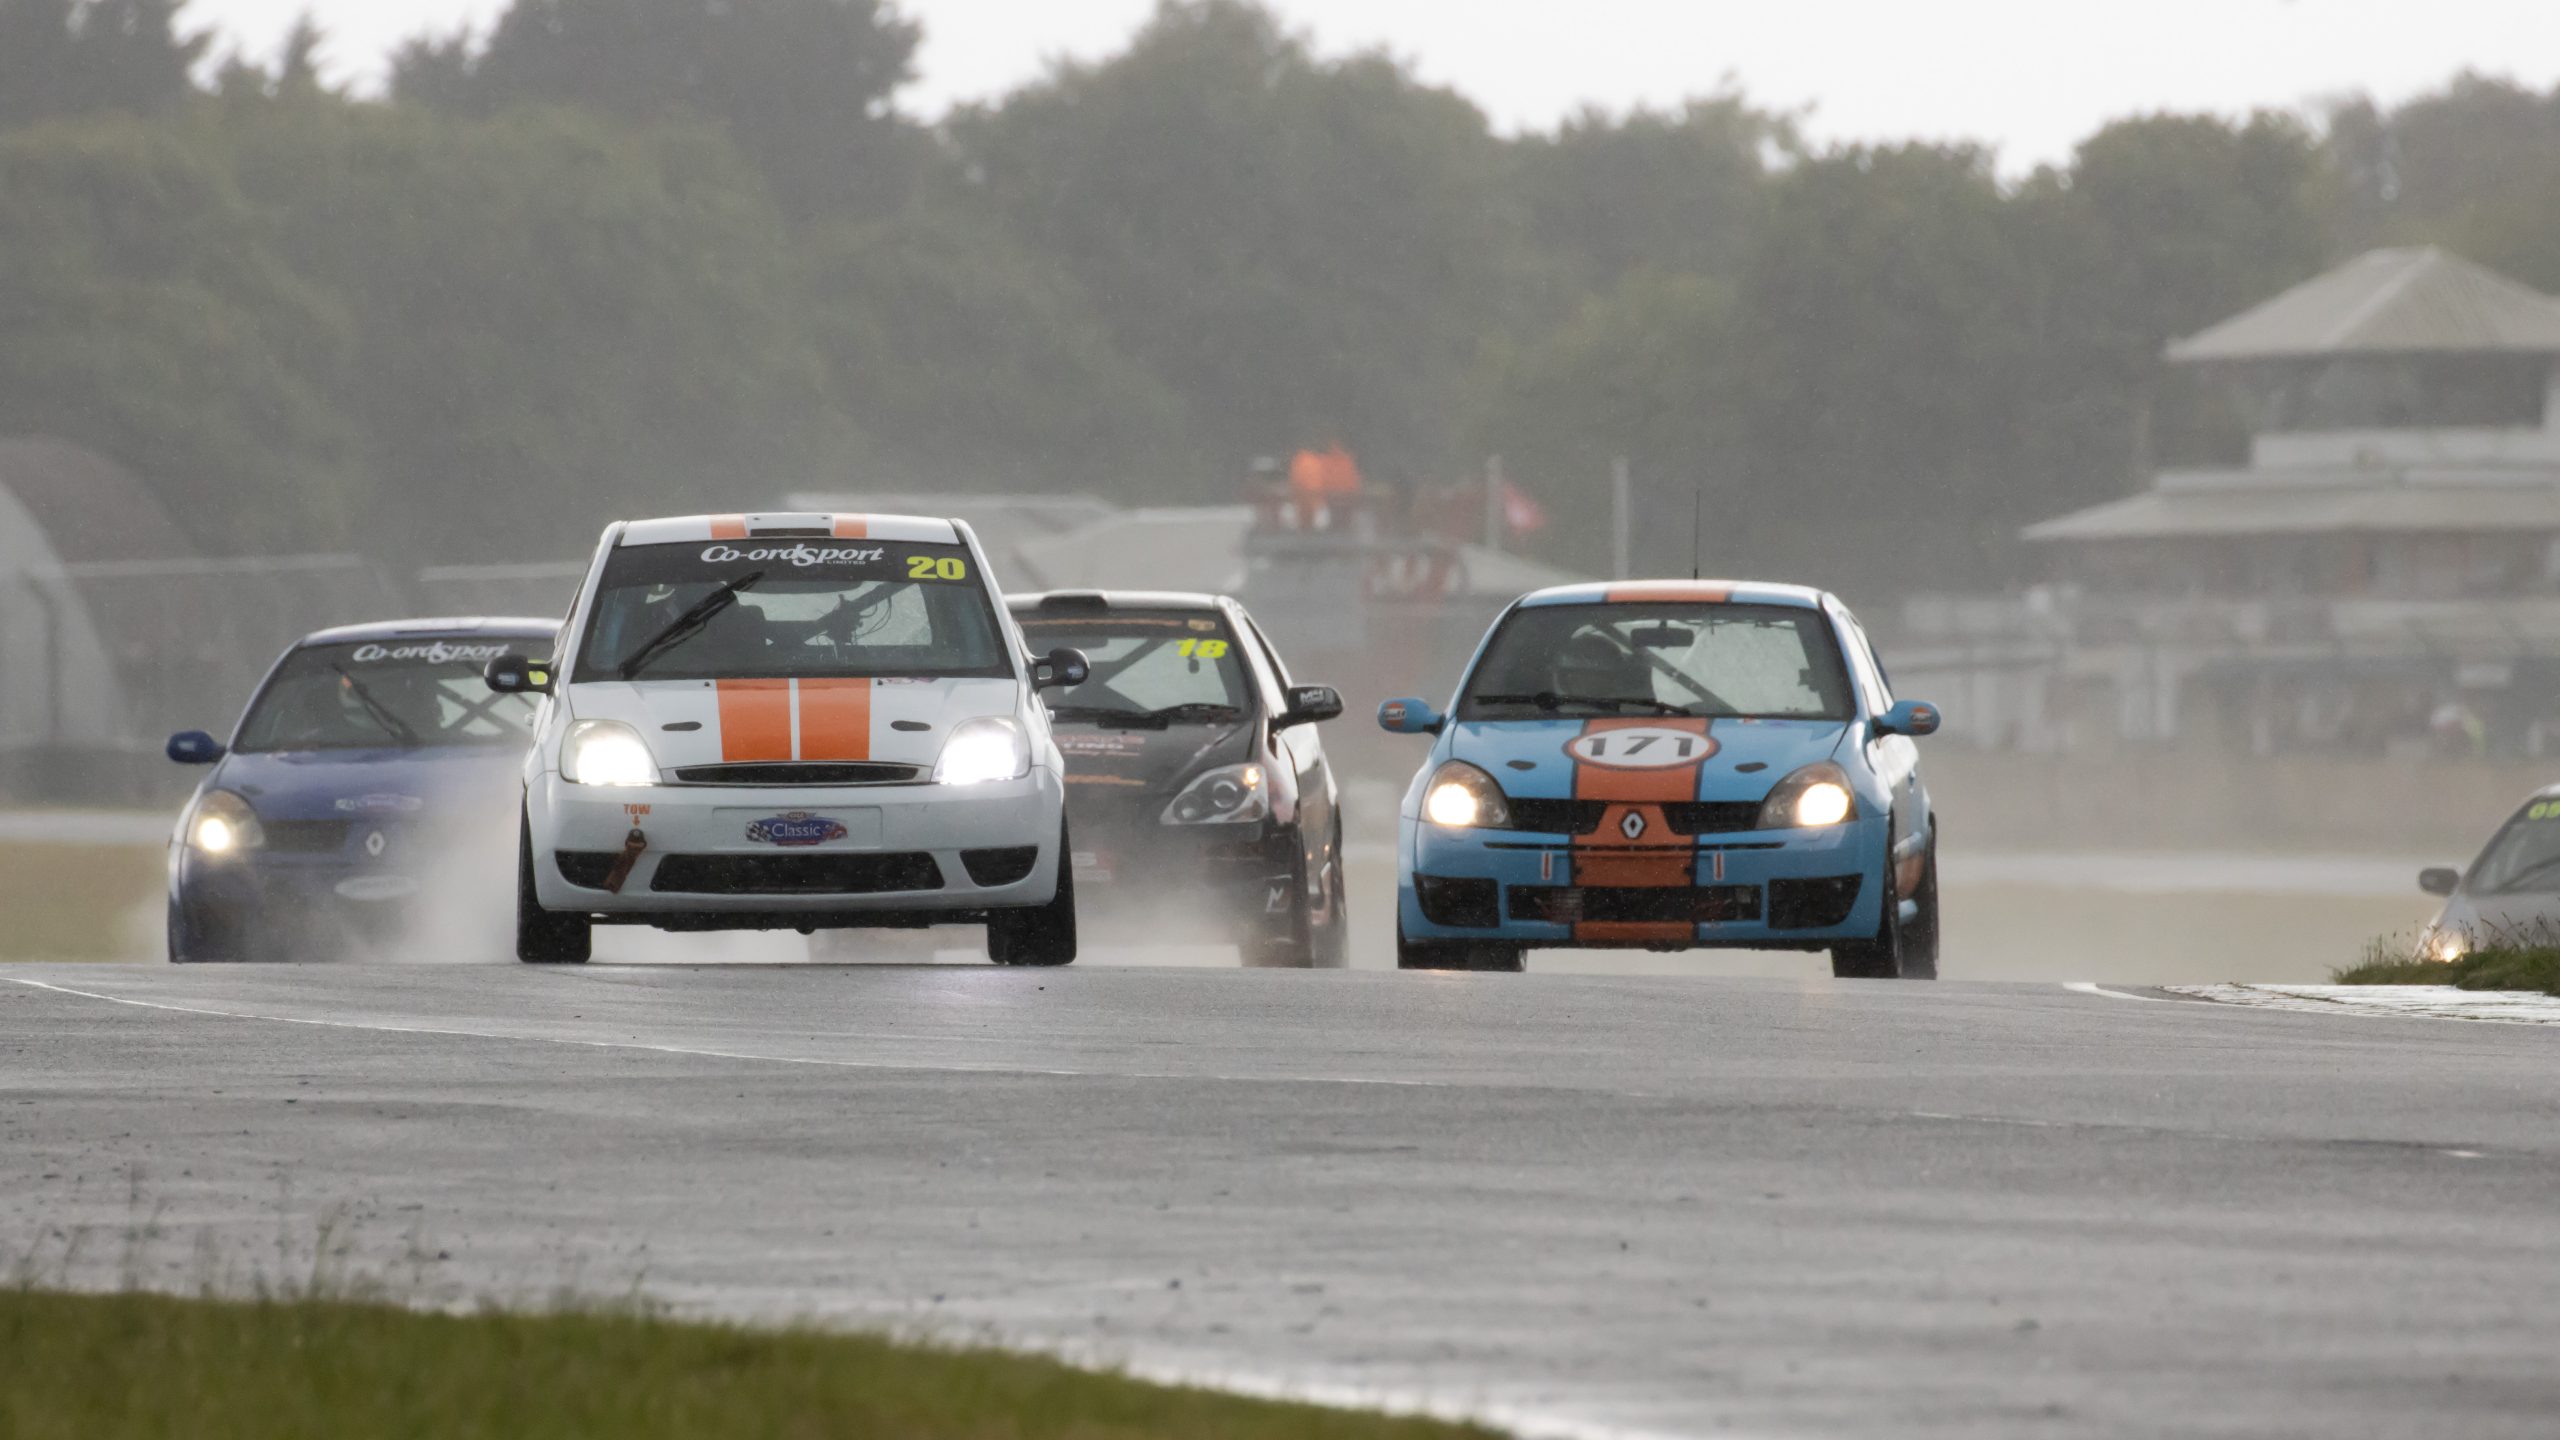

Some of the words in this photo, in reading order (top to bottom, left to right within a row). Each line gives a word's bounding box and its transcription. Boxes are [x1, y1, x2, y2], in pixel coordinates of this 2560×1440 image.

[906, 556, 966, 580] 20
[1176, 637, 1229, 659] 18
[1587, 735, 1695, 757] 171
[623, 804, 652, 816] TOW
[771, 823, 822, 838] Classic
